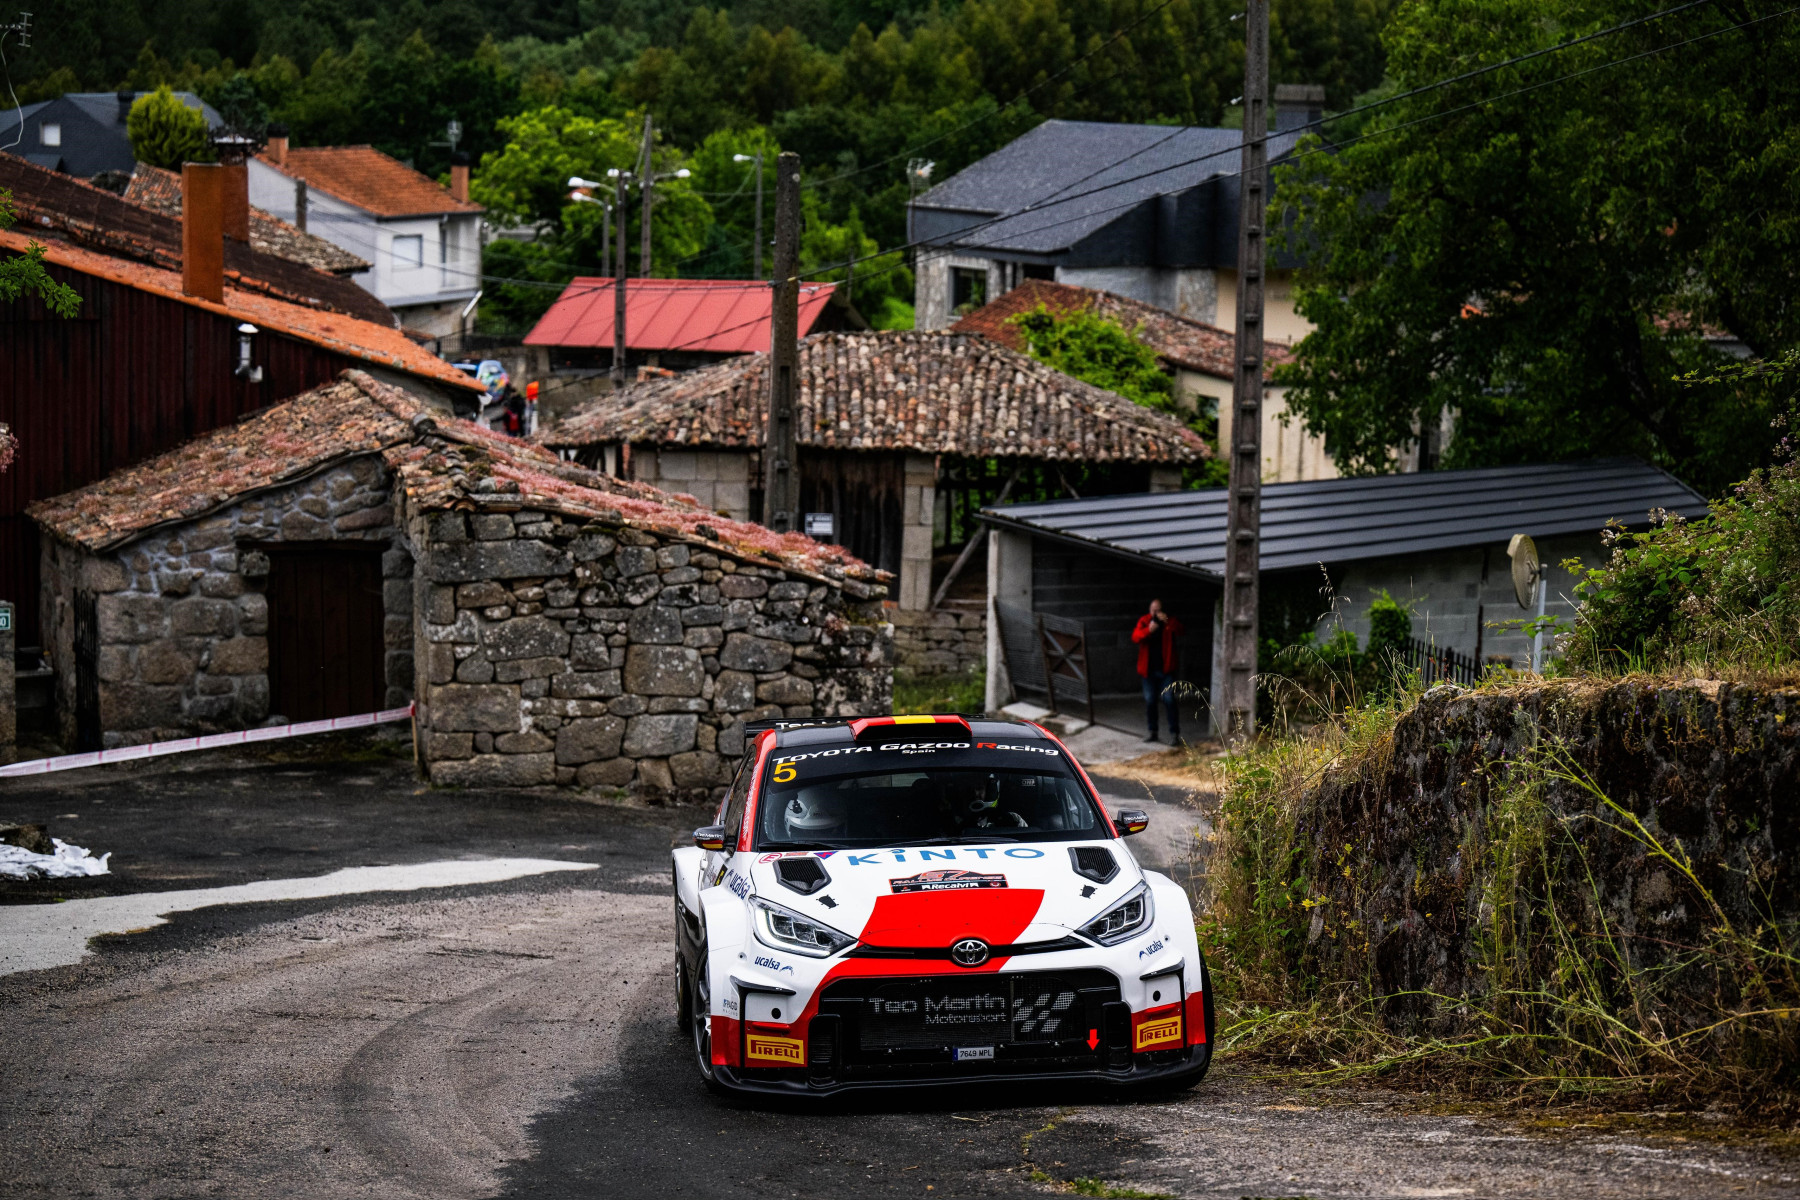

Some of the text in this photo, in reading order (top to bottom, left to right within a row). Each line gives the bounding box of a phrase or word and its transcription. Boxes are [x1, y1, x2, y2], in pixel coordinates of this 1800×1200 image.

[772, 742, 1059, 764] TOYOTA GAZOO Racing
[772, 761, 798, 783] 5
[754, 955, 781, 971] ucalsa
[868, 997, 918, 1013] Teo
[925, 1012, 1007, 1025] Motorsport
[1139, 1020, 1179, 1044] PIRELLI
[750, 1039, 800, 1059] PIRELLI
[959, 1050, 977, 1058] 7649
